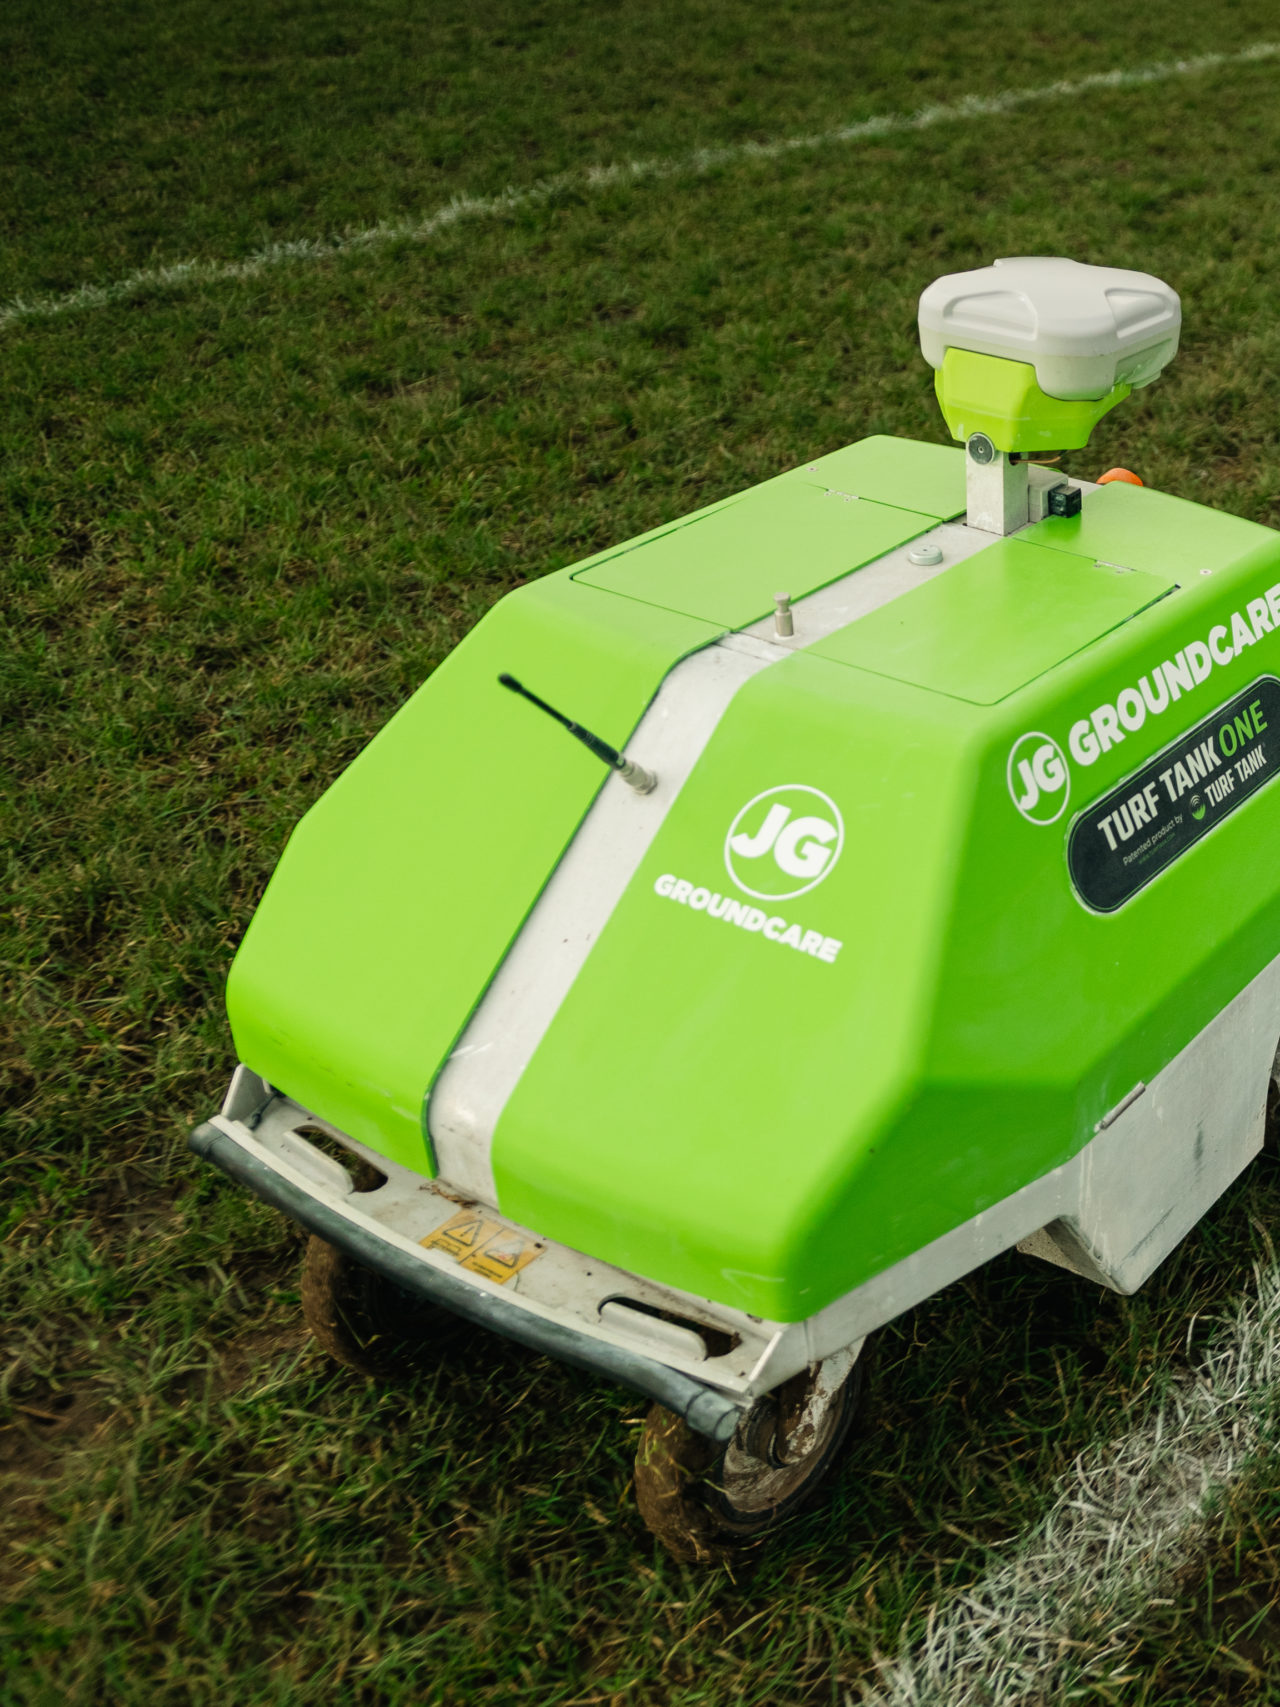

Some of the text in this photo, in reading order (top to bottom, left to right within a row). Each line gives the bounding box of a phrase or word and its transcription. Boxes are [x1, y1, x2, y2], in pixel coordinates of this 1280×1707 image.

[1017, 744, 1067, 811] JG
[1097, 781, 1160, 851] TURF
[1159, 736, 1222, 802] TANK
[1219, 699, 1268, 757] ONE
[1204, 744, 1267, 807] TURF TANK
[730, 802, 838, 878] JG
[1123, 838, 1152, 866] Patented
[1151, 820, 1176, 845] product
[1174, 812, 1183, 824] by
[653, 873, 843, 964] GROUNDCARE
